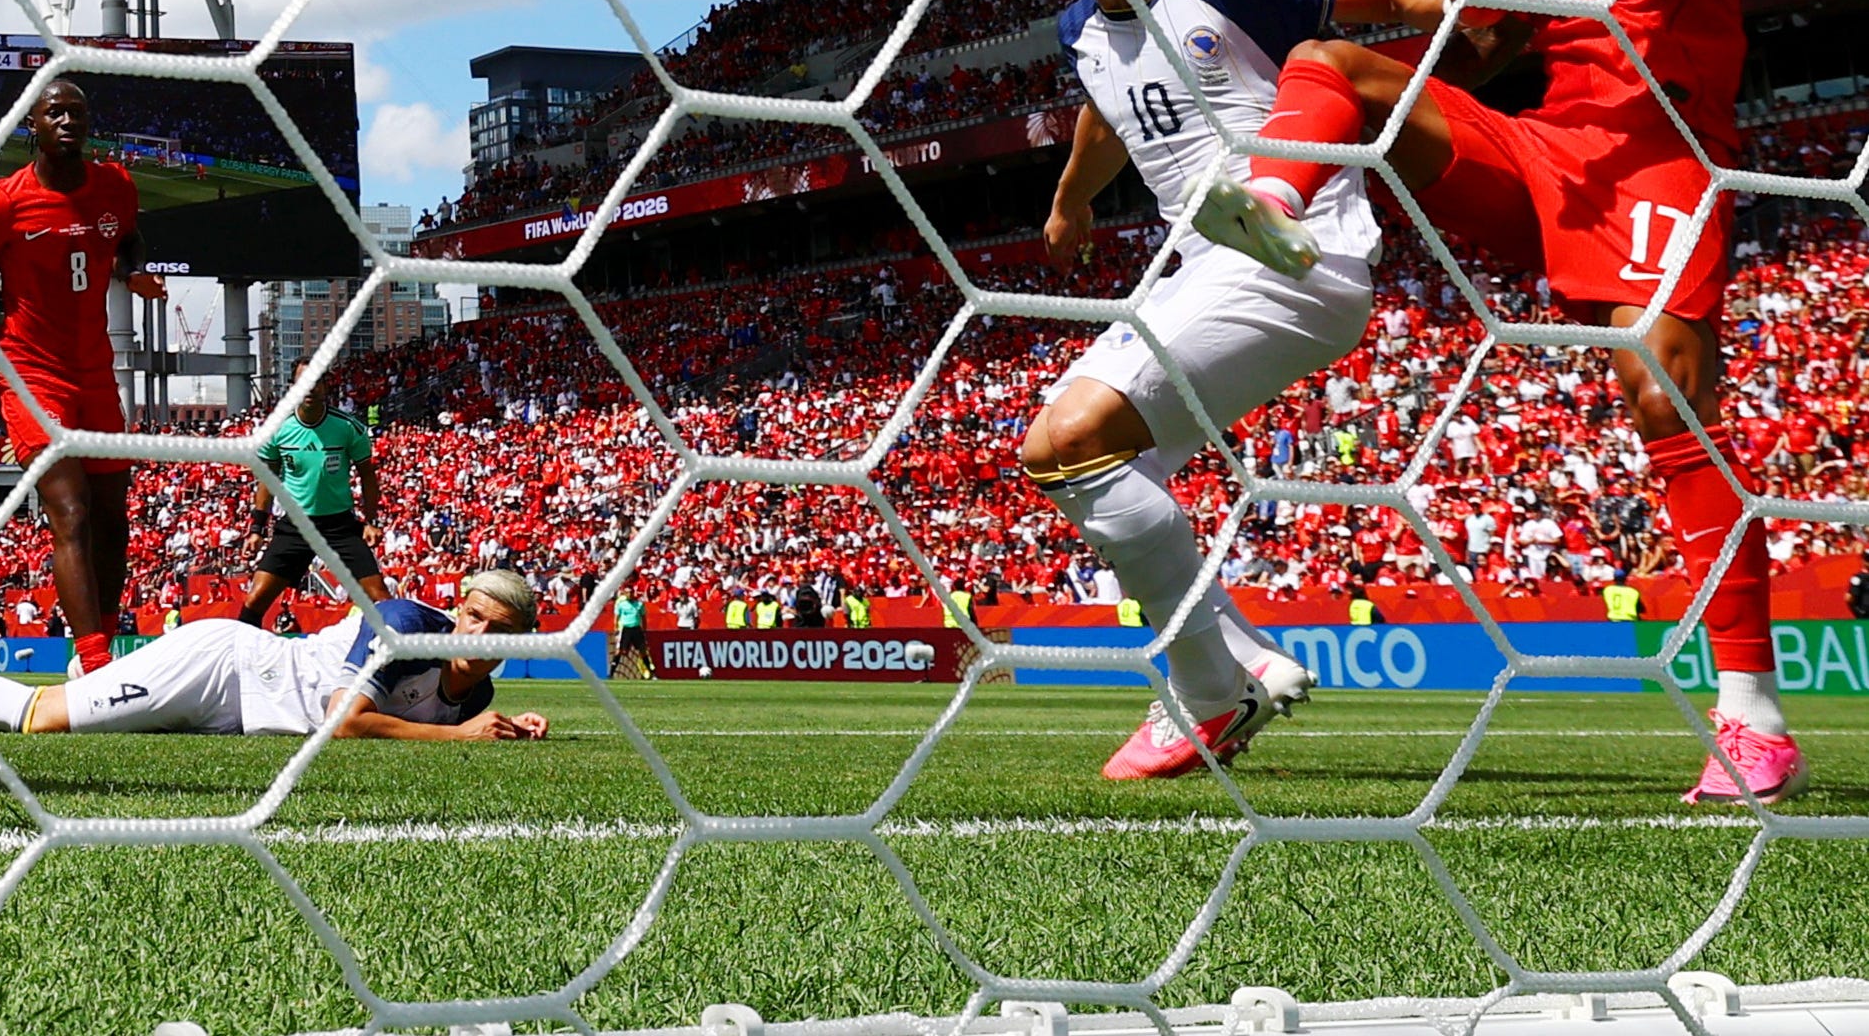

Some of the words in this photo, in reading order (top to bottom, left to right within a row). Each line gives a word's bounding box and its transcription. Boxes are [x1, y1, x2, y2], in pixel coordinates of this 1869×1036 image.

[1126, 82, 1182, 142] 10
[524, 220, 551, 240] FIFA
[622, 195, 669, 221] 2026
[1628, 200, 1692, 269] 17
[70, 251, 88, 293] 8
[663, 641, 706, 669] FIFA
[708, 641, 789, 669] WORLD
[792, 640, 839, 669] CUP
[1257, 627, 1427, 689] mco
[109, 682, 149, 707] 4
